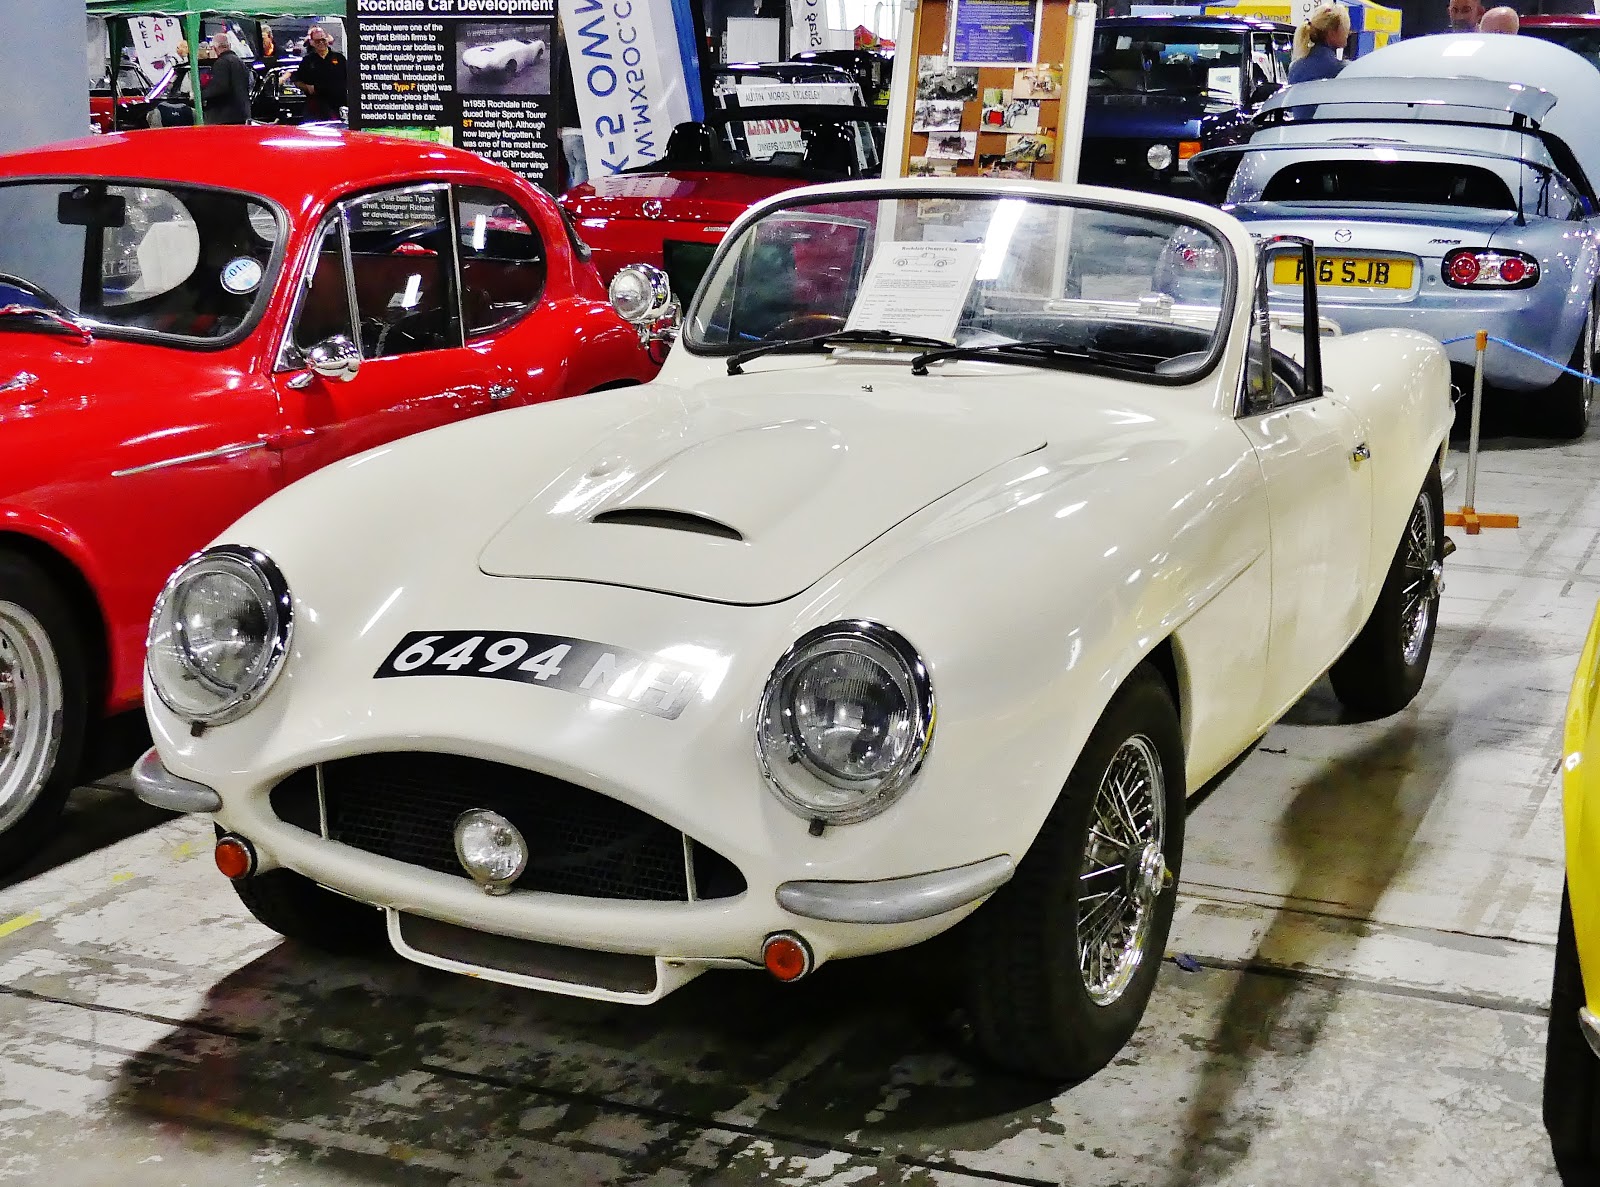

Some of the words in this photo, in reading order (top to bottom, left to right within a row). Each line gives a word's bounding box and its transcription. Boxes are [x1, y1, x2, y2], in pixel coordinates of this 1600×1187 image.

[357, 0, 424, 11] Rochdale
[428, 0, 454, 11] Car
[457, 0, 554, 14] Development
[360, 34, 375, 42] very
[394, 54, 415, 62] quickly
[417, 54, 433, 62] grew
[394, 83, 410, 92] Type
[417, 83, 437, 92] (right)
[367, 93, 389, 101] simple
[390, 93, 421, 101] one-piece
[423, 93, 440, 101] shell,
[488, 100, 520, 108] Rochdale
[521, 100, 539, 108] intro-
[463, 110, 483, 118] duced
[485, 110, 500, 118] their
[502, 110, 524, 119] Sports
[526, 110, 547, 118] Tourer
[463, 120, 473, 128] ST
[474, 120, 495, 128] model
[497, 120, 514, 129] (left).
[516, 120, 545, 129] Although
[463, 130, 477, 138] now
[478, 130, 501, 139] largely
[503, 130, 534, 139] forgotten,
[536, 130, 541, 138] it
[463, 140, 476, 148] was
[478, 140, 491, 148] one
[492, 140, 500, 148] of
[501, 140, 512, 148] the
[514, 140, 531, 148] most
[532, 140, 548, 148] inno-
[521, 151, 544, 160] bodies,
[530, 161, 548, 170] wings
[414, 195, 430, 203] Type
[382, 203, 407, 211] designer
[1341, 261, 1390, 285] SJB
[392, 635, 573, 681] 6494
